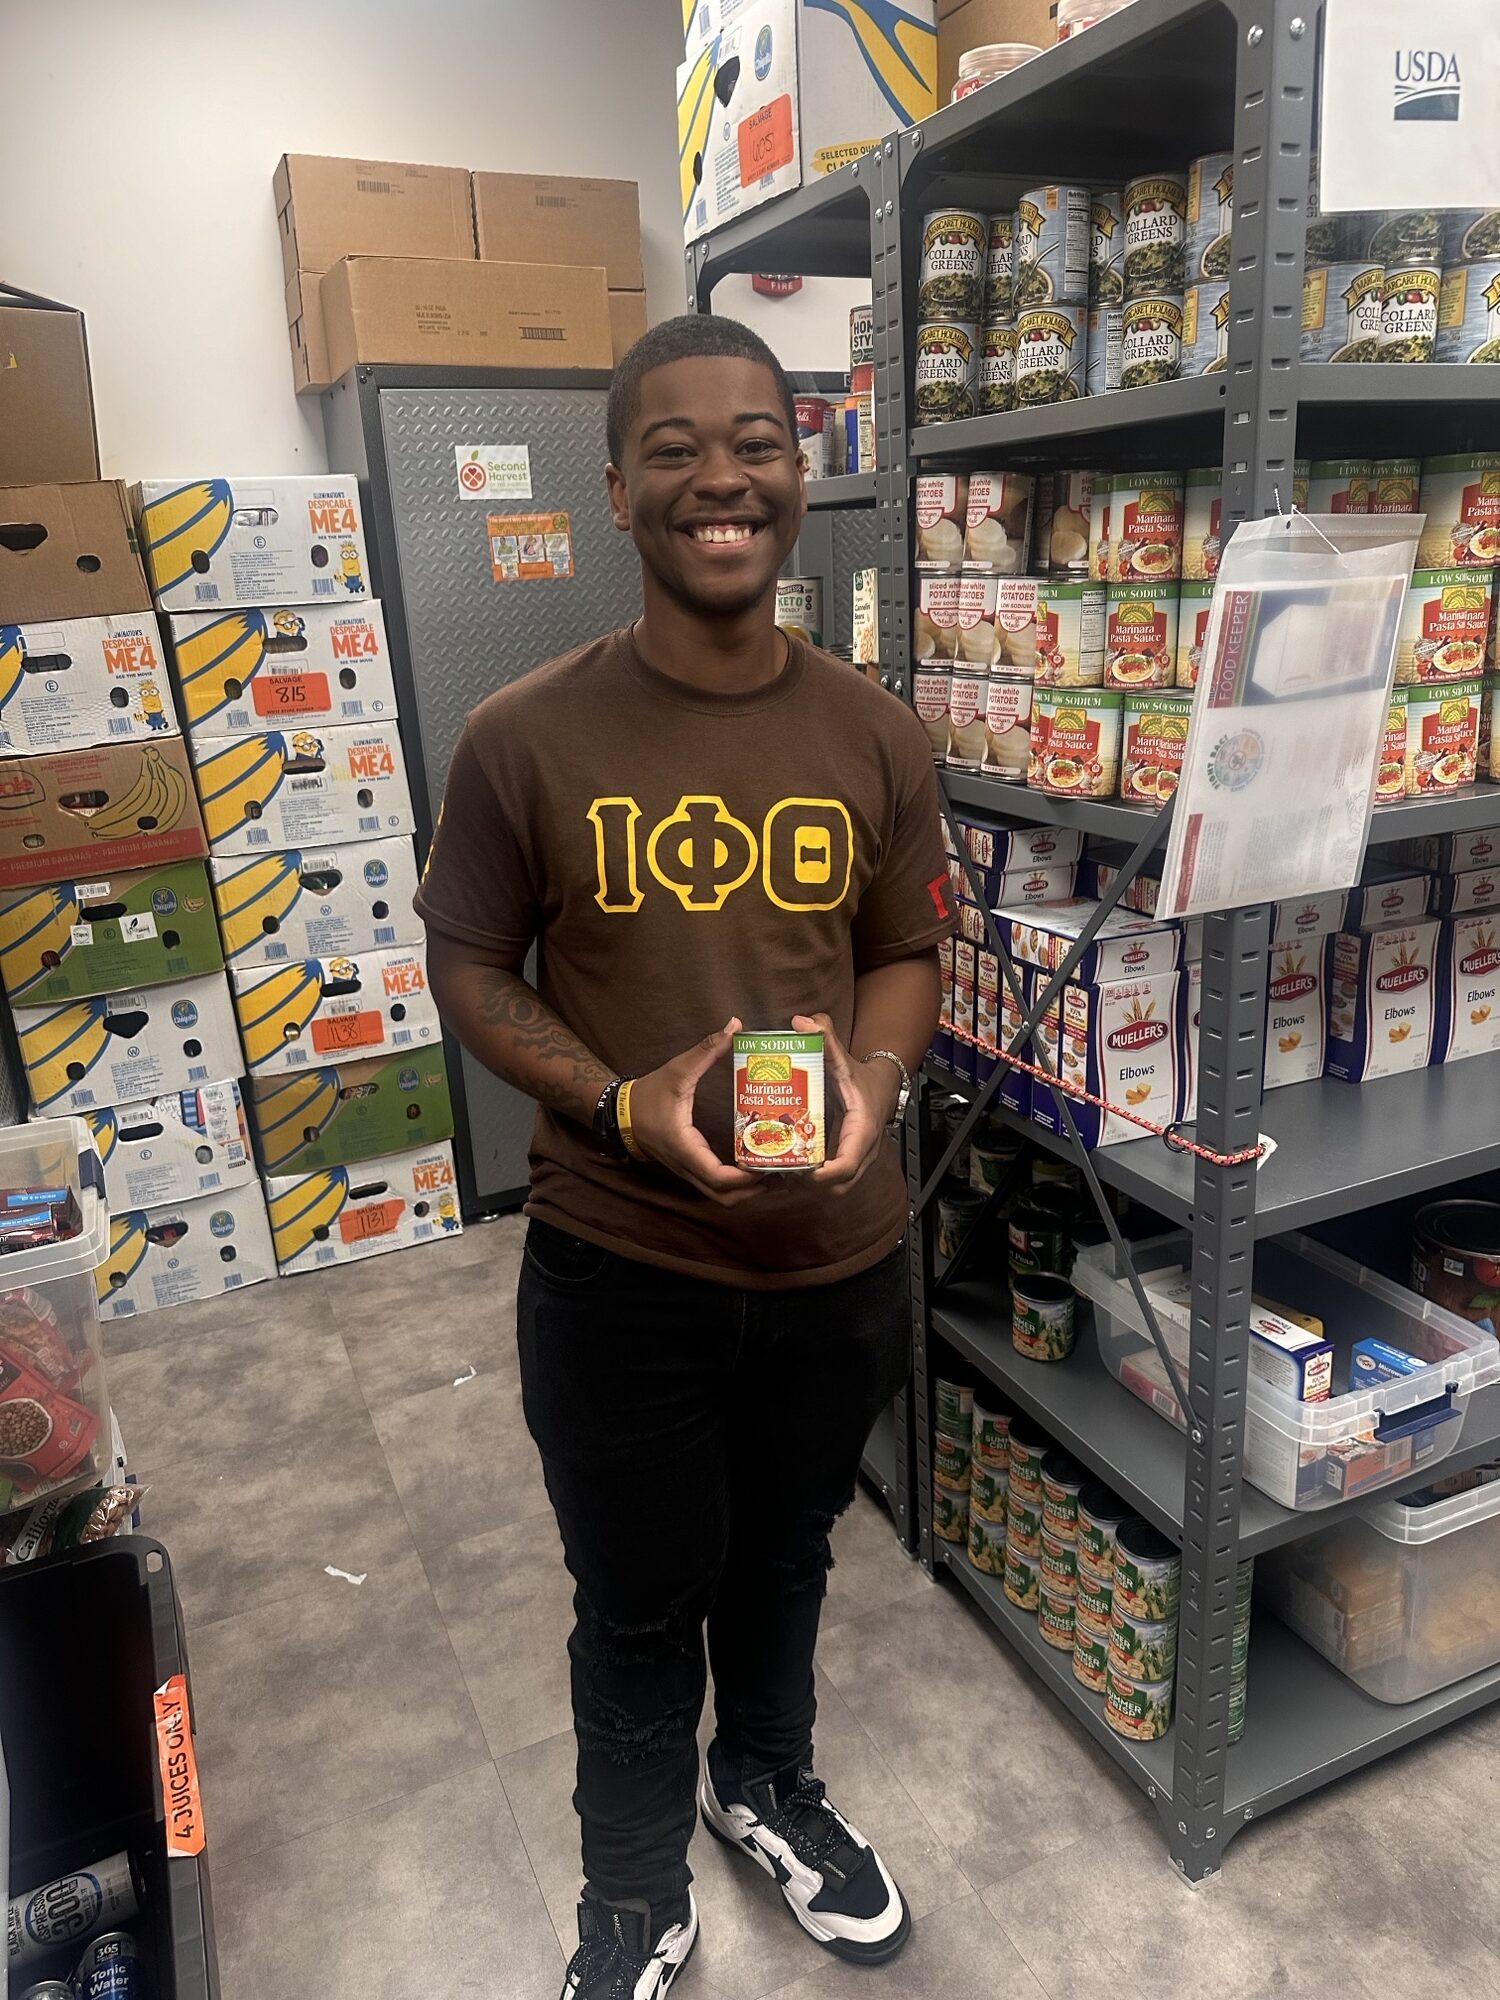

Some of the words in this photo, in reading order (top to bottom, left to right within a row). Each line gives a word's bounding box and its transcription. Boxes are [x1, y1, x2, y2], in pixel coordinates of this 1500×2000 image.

[1395, 51, 1460, 83] USDA
[749, 107, 772, 129] SALVAGE
[821, 147, 859, 160] SELECTED
[1126, 215, 1178, 234] COLLARD
[1127, 227, 1172, 244] GREENS
[929, 250, 978, 261] COLLARD
[931, 261, 974, 270] GREENS
[771, 281, 793, 290] FIRE
[1356, 306, 1381, 319] COLL
[1381, 309, 1436, 323] COLLARD
[854, 320, 873, 335] HOM
[1384, 321, 1433, 334] GREENS
[1123, 335, 1173, 350] COLLARD
[1125, 346, 1169, 360] GREENS
[1019, 356, 1059, 369] GREENS
[919, 369, 957, 379] GREENS
[488, 462, 527, 471] Second
[1471, 458, 1493, 468] LOW
[489, 472, 528, 481] Harvest
[1129, 478, 1149, 488] LOW
[308, 499, 353, 509] DESPICABLE
[1468, 507, 1492, 516] Pasta
[1136, 513, 1176, 524] Marinara
[1128, 524, 1154, 534] Pasta
[1430, 574, 1453, 585] LOW
[1001, 592, 1034, 601] POTATOES
[1111, 590, 1127, 598] LOW
[1130, 589, 1167, 598] SODIUM
[779, 597, 803, 607] KETO
[330, 624, 374, 636] DESPICABLE
[1116, 625, 1155, 633] Marinara
[1429, 622, 1455, 632] Pasta
[102, 637, 151, 649] DESPICABLE
[1110, 634, 1131, 643] Pasta
[1133, 633, 1161, 642] Sauce
[1219, 659, 1236, 702] FOOD
[1229, 594, 1249, 658] KEEPER
[269, 677, 302, 685] SALVAGE
[276, 685, 306, 704] 815
[917, 687, 948, 695] POTATOES
[1429, 689, 1450, 699] LOW
[1064, 695, 1101, 706] SODIUM
[1132, 701, 1151, 710] LOW
[1051, 729, 1086, 740] Marinara
[1429, 735, 1452, 745] Pasta
[348, 744, 391, 756] DESPICABLE
[1064, 740, 1093, 750] Sauce
[1130, 746, 1152, 755] Pasta
[10, 857, 50, 871] PREMIUM
[52, 852, 92, 865] BANANAS
[102, 843, 139, 856] PREMIUM
[141, 837, 181, 850] BANANAS
[1124, 952, 1148, 962] MUELLER'S
[382, 962, 420, 975] DESPICABLE
[1124, 964, 1145, 973] Elbows
[1380, 968, 1425, 988] MUELLER'S
[1467, 988, 1496, 1002] Elbows
[1384, 1005, 1416, 1020] Elbows
[327, 1015, 357, 1024] SALVAGE
[1273, 1015, 1305, 1029] Elbows
[1112, 1023, 1165, 1047] MUELLER'S
[738, 1040, 758, 1050] LOW
[760, 1040, 806, 1050] SODIUM
[1120, 1065, 1155, 1081] Elbows
[745, 1083, 793, 1094] Marinara
[739, 1094, 764, 1105] Pasta
[767, 1095, 802, 1106] Sauce
[412, 1160, 449, 1173] DESPICABLE
[1107, 1686, 1142, 1714] SUMMER
[1109, 1697, 1136, 1717] CRISP
[168, 1752, 193, 1823] JUICES
[33, 1892, 52, 1940] ESPRESSO
[97, 1943, 119, 1960] 365
[91, 1965, 126, 1982] Tonic
[90, 1976, 129, 1995] Water
